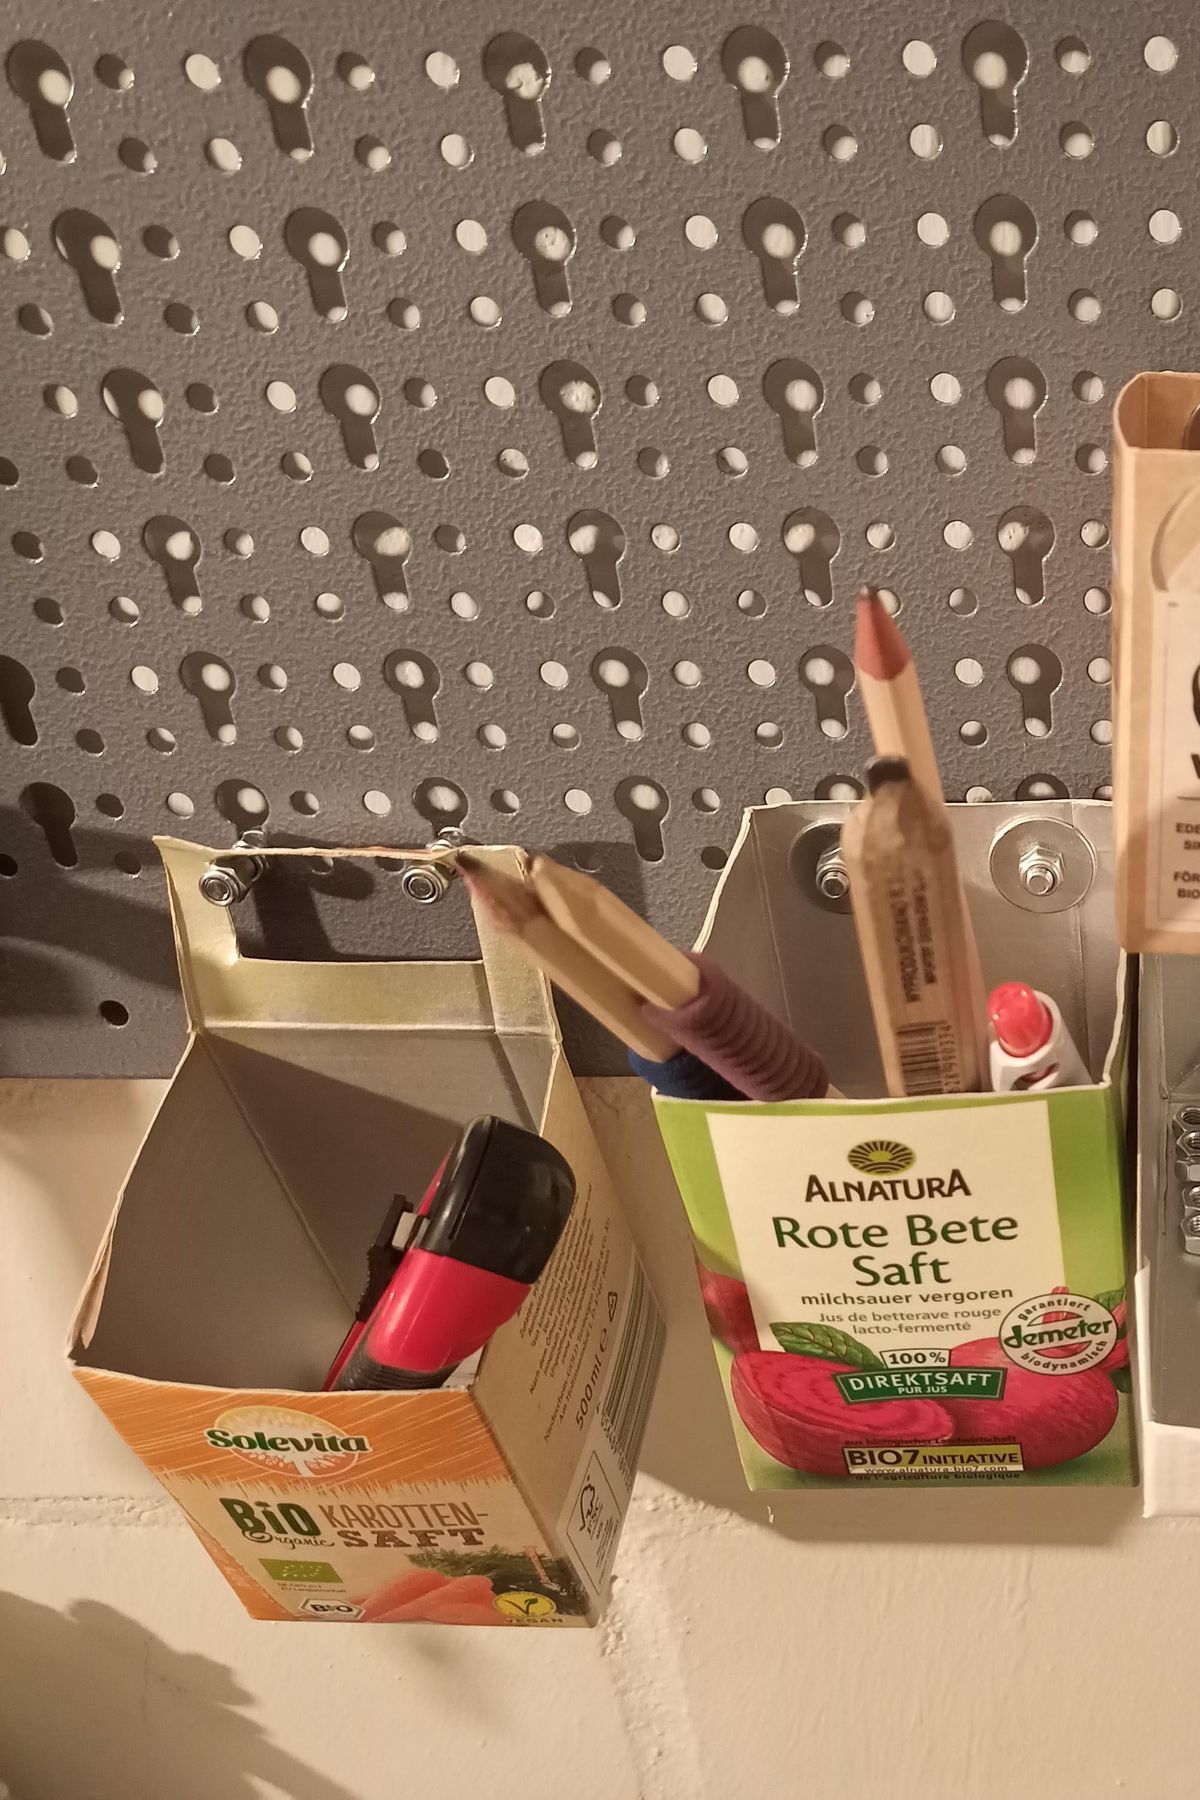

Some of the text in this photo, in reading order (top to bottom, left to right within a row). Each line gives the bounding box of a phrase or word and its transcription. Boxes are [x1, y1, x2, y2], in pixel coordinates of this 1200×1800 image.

[805, 1168, 972, 1203] ALNATURA
[772, 1214, 1019, 1249] Rote Bete
[852, 1251, 952, 1287] Saft
[801, 1288, 1014, 1306] milchsauer vergoren
[819, 1307, 1001, 1323] Jus de betterave rouge
[1018, 1298, 1091, 1321] garantiert
[853, 1321, 971, 1335] lacto-fermenté
[1003, 1318, 1113, 1349] demeter
[1021, 1340, 1107, 1371] biodynamisch
[576, 1383, 593, 1430] 500
[592, 1354, 602, 1387] ml
[849, 1372, 992, 1391] DIREKTSAFT
[898, 1385, 947, 1395] PUR JUS
[206, 1429, 370, 1452] Solevita
[923, 1452, 1019, 1465] INITIATIVE
[954, 1472, 1021, 1480] biologique
[219, 1498, 489, 1536] BiO KAROTTEN-
[242, 1528, 336, 1550] Organic
[337, 1529, 485, 1548] SAFT
